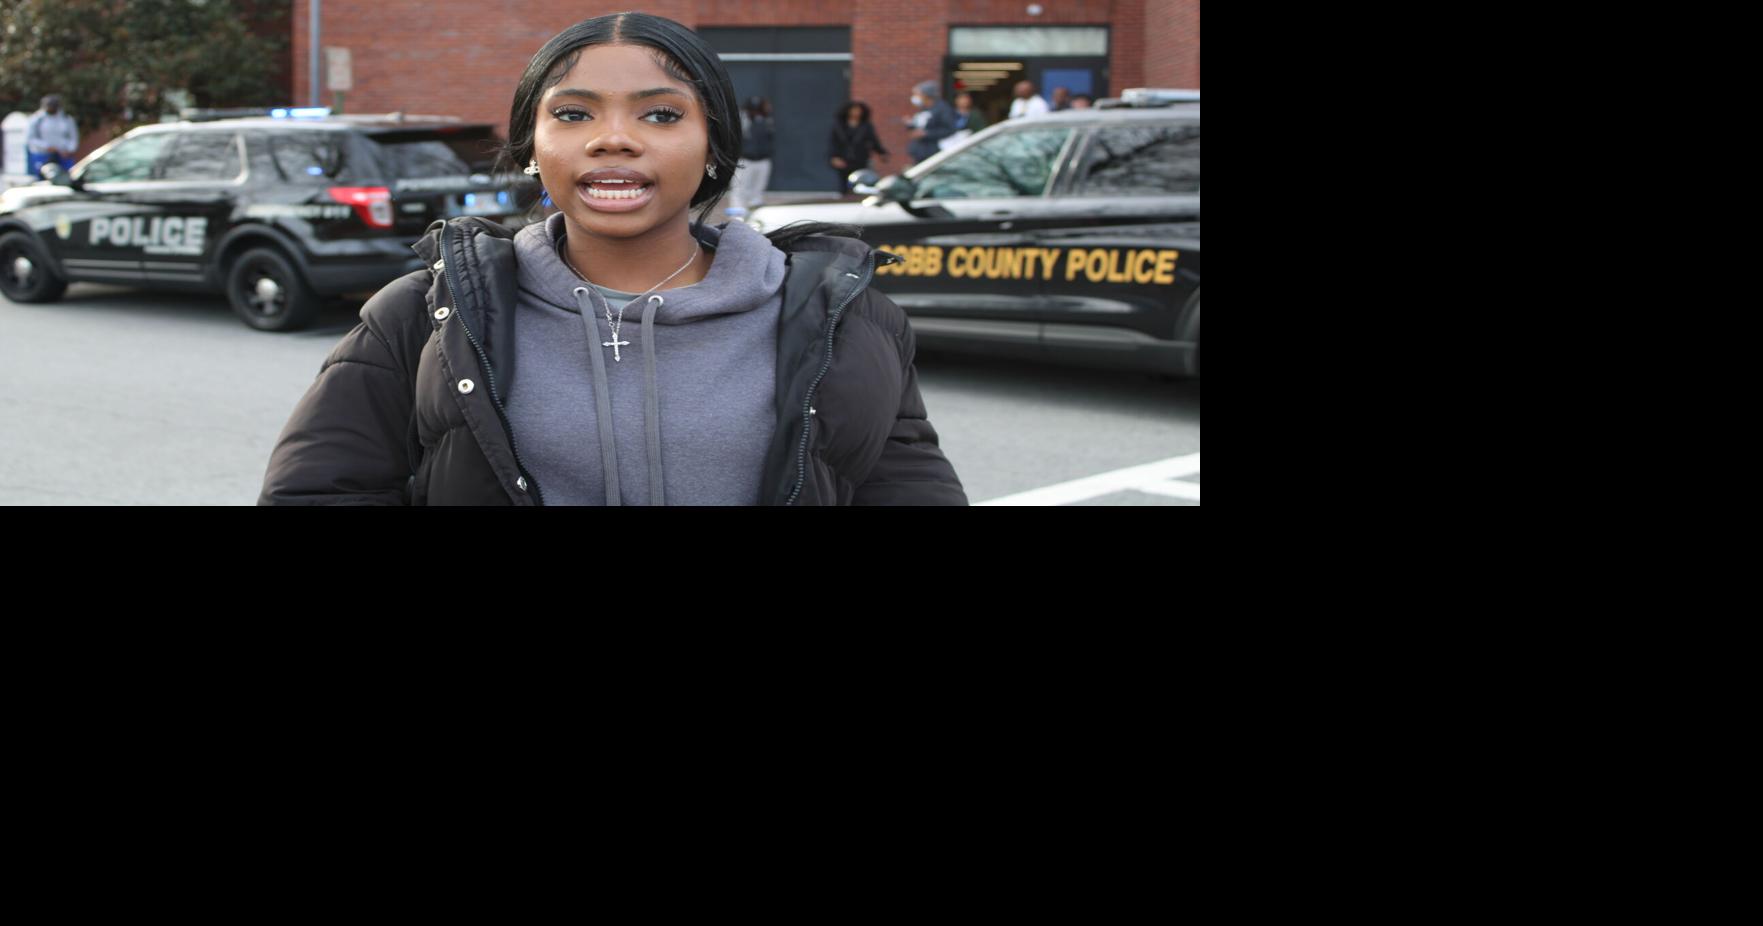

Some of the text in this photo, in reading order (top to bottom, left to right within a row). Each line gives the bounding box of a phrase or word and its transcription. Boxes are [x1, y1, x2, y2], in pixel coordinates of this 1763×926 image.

[88, 216, 208, 246] POLICE
[947, 246, 1061, 279] COUNTY
[1065, 248, 1179, 284] POLICE
